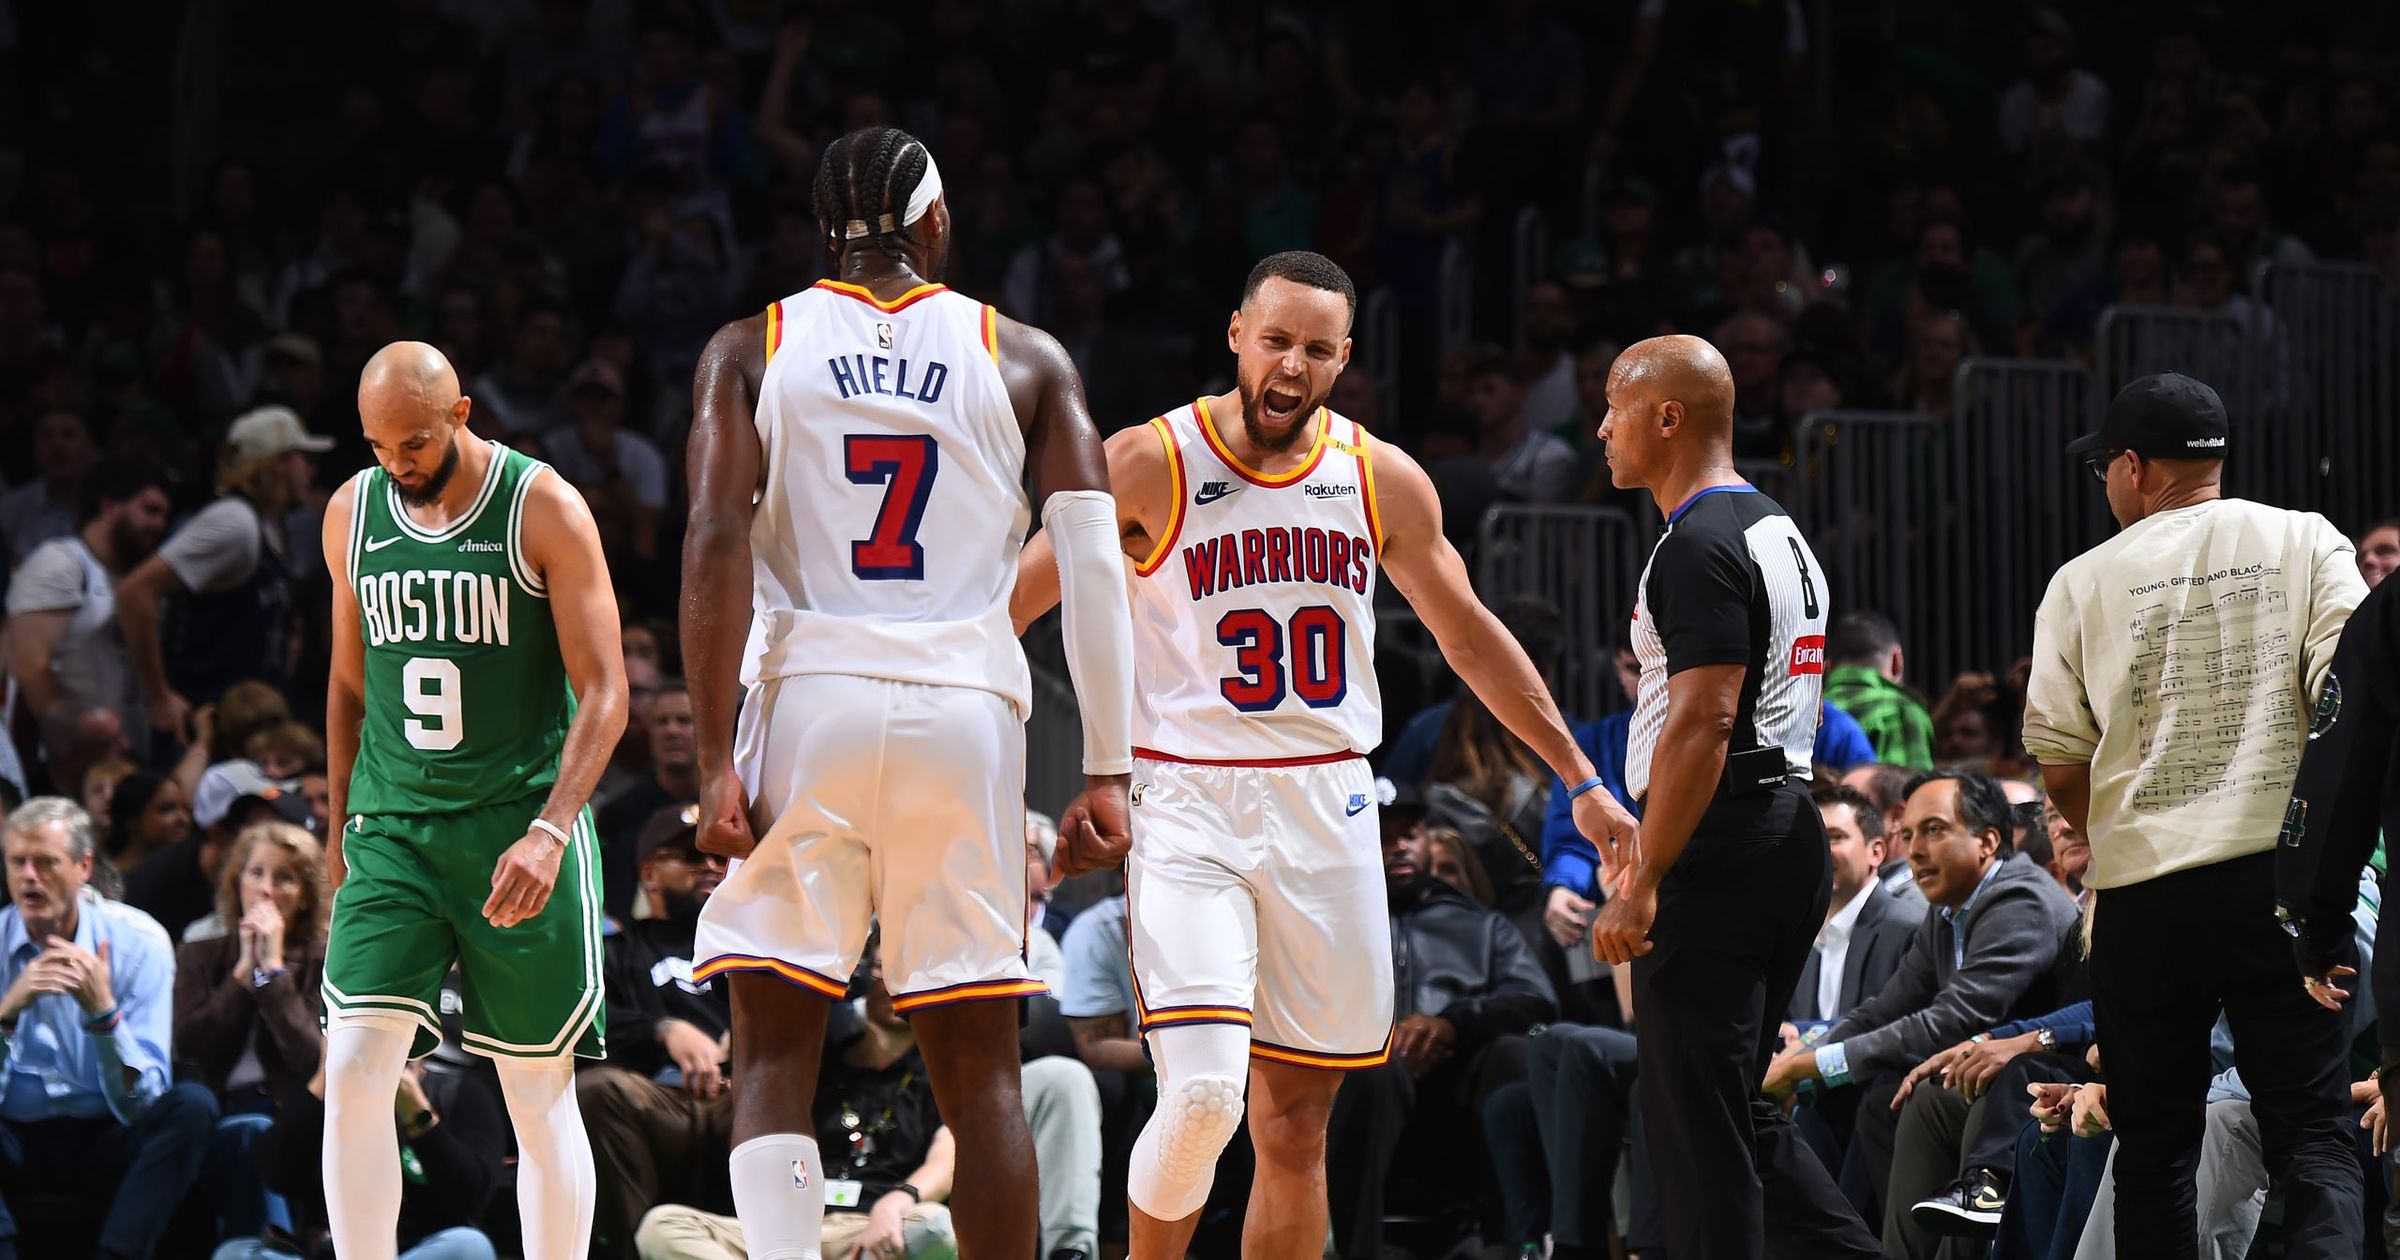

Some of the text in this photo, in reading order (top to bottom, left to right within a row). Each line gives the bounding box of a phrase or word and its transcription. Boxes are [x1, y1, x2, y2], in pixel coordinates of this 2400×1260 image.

[828, 354, 948, 403] HIELD
[843, 434, 939, 581] 7
[1201, 482, 1229, 495] NIKE
[1305, 483, 1356, 497] Rakuten
[458, 538, 503, 552] Amica
[1182, 526, 1371, 601] WARRIORS
[360, 570, 509, 647] BOSTON
[1788, 536, 1819, 620] 8
[2129, 580, 2168, 597] YOUNG,
[2171, 577, 2205, 586] GIFTED
[2207, 570, 2227, 583] AND
[2230, 562, 2263, 576] BLACK
[1216, 604, 1348, 713] 30
[402, 657, 464, 750] 9
[2282, 797, 2307, 847] 4
